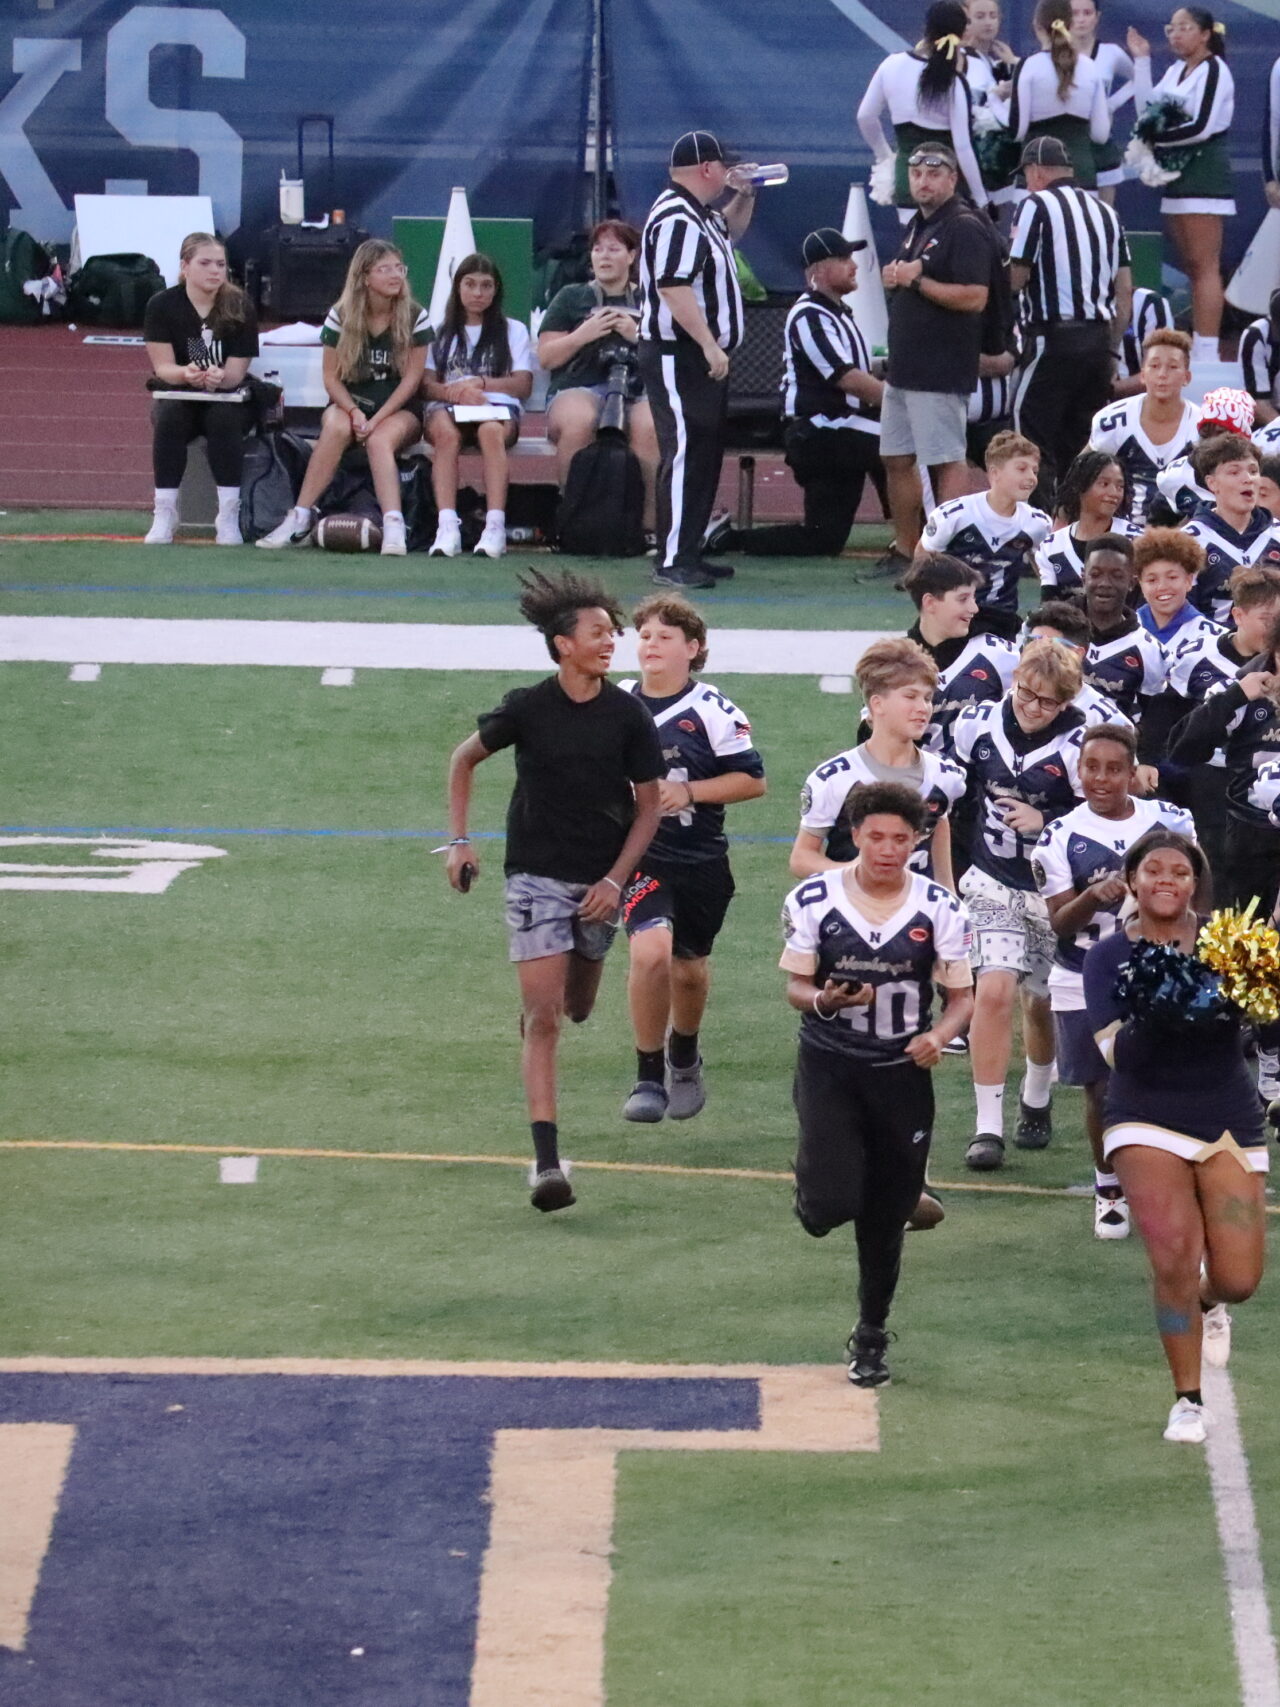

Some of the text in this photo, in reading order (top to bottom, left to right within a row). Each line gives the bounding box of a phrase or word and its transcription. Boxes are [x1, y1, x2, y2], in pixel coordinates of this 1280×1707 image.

[991, 535, 1000, 547] N
[1089, 649, 1100, 661] N
[702, 690, 735, 715] 2
[1113, 839, 1126, 851] N
[794, 870, 829, 909] 0
[869, 931, 882, 944] N
